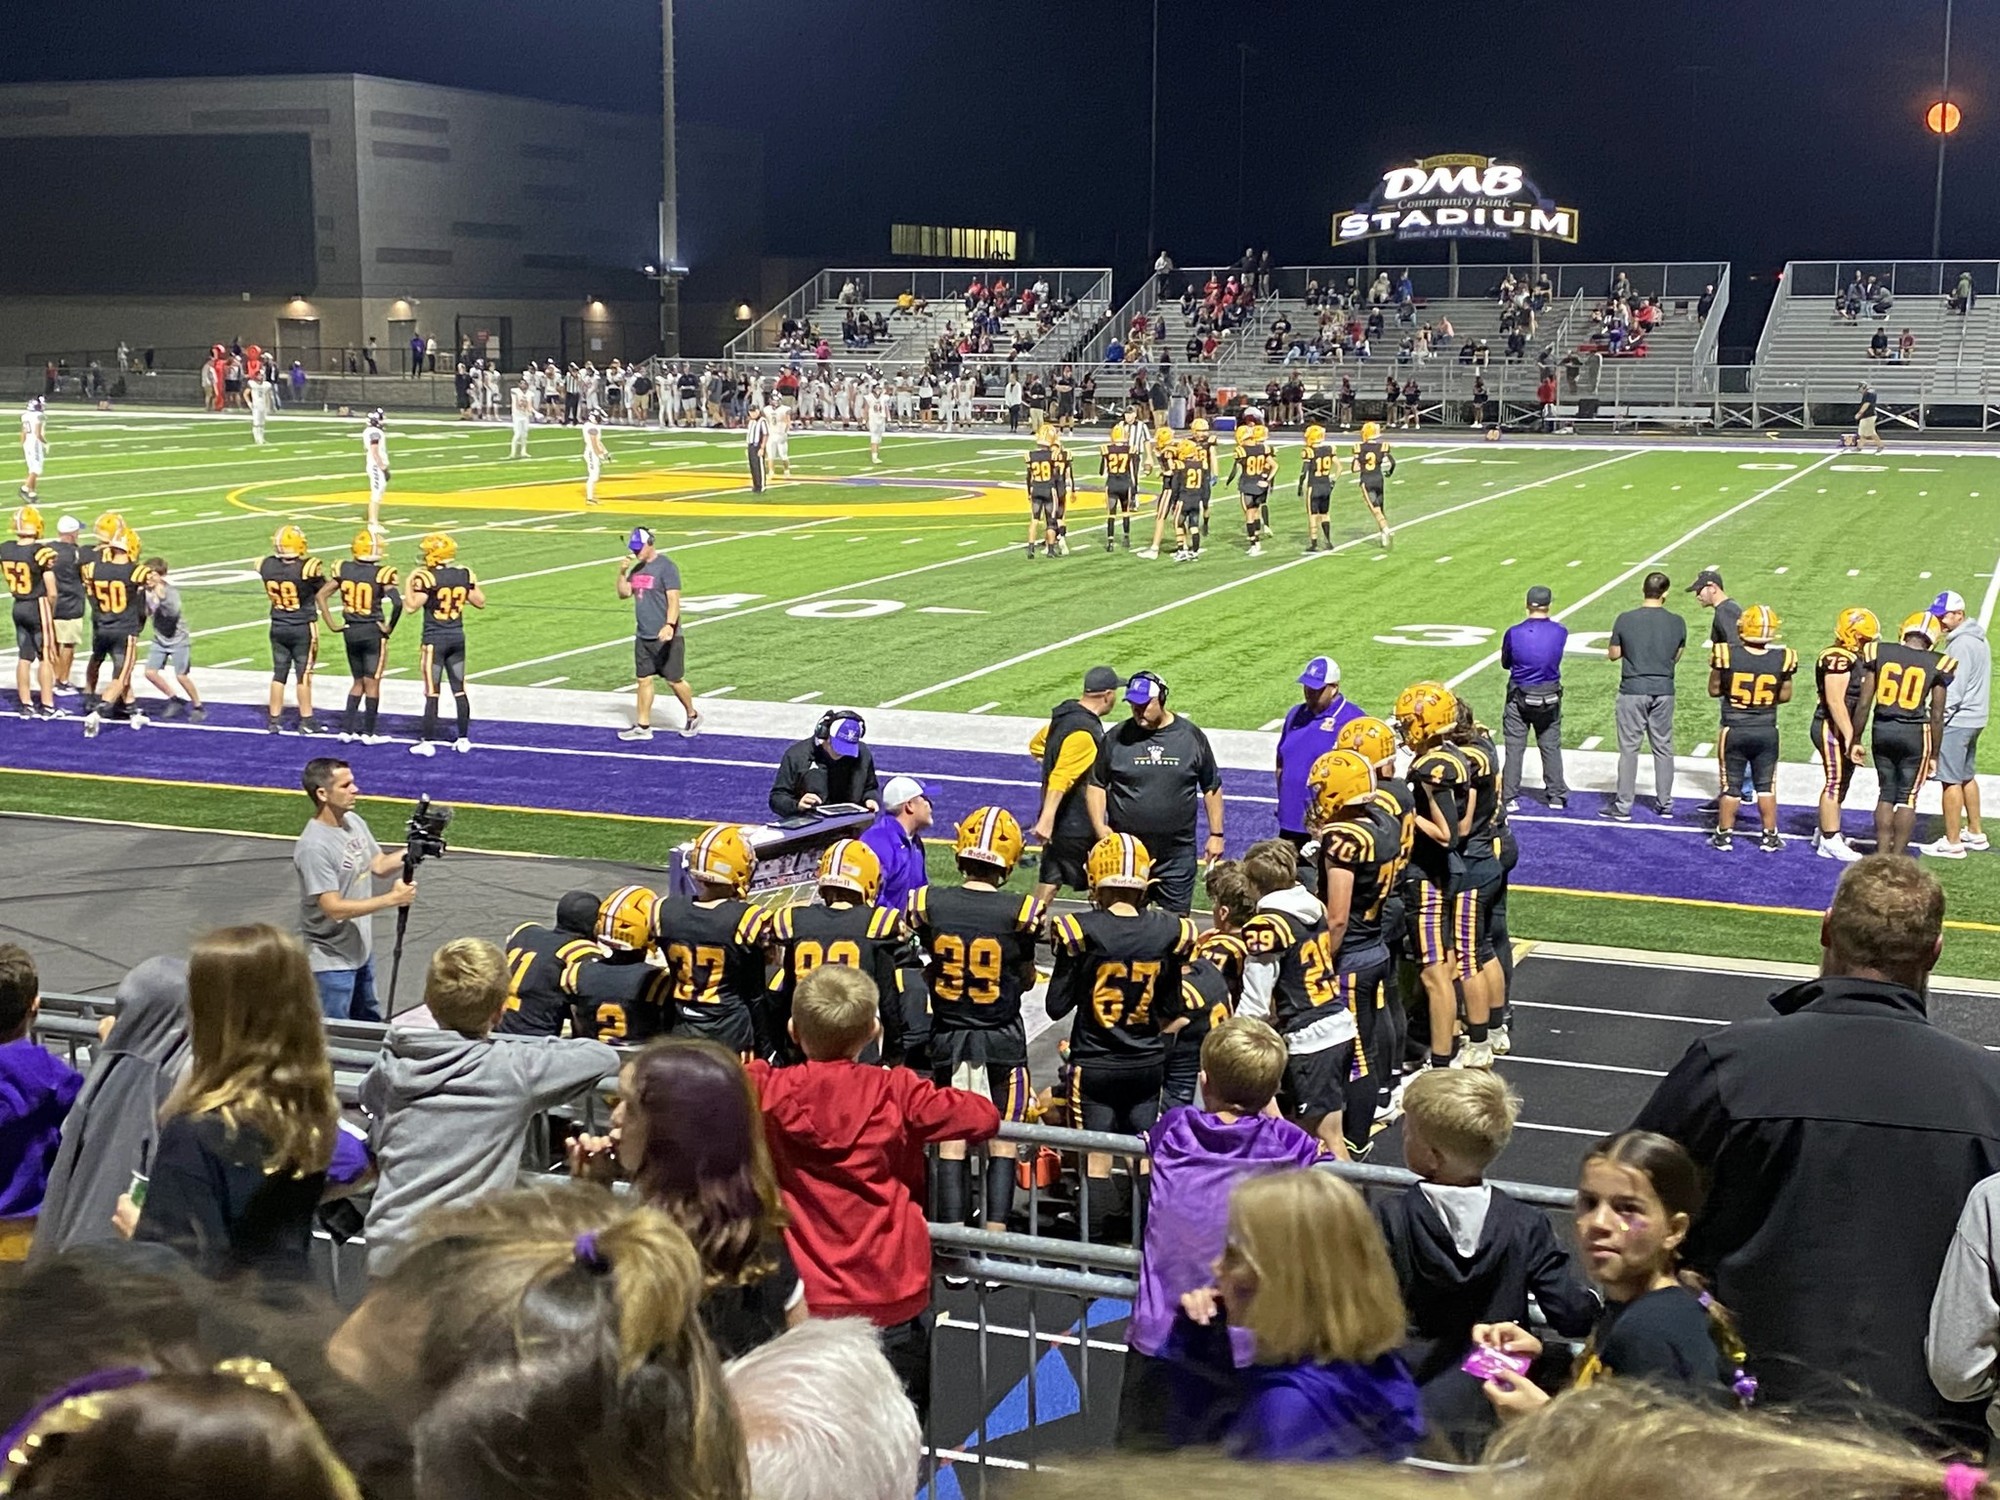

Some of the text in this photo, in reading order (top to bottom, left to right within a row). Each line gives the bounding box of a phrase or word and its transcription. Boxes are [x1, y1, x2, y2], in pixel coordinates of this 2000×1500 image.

[1383, 166, 1523, 200] DMB
[1397, 197, 1512, 210] Community Bank
[1339, 208, 1570, 237] STADIUM
[1399, 227, 1508, 239] Home of the Norskies
[1031, 460, 1053, 482] 28
[1107, 453, 1130, 474] 27
[1314, 456, 1333, 477] 19
[1364, 451, 1377, 471] 3
[1185, 468, 1203, 489] 21
[2, 560, 33, 595] 53
[94, 580, 128, 615] 50
[340, 580, 373, 616] 30
[433, 586, 467, 621] 33
[1826, 655, 1850, 671] 72
[1730, 672, 1778, 709] 56
[1876, 661, 1926, 710] 60
[967, 849, 998, 863] Riddell
[1327, 834, 1358, 863] 70
[821, 876, 850, 887] Riddell
[1245, 929, 1275, 952] 29
[933, 934, 1002, 1004] 39
[1092, 961, 1161, 1029] 67
